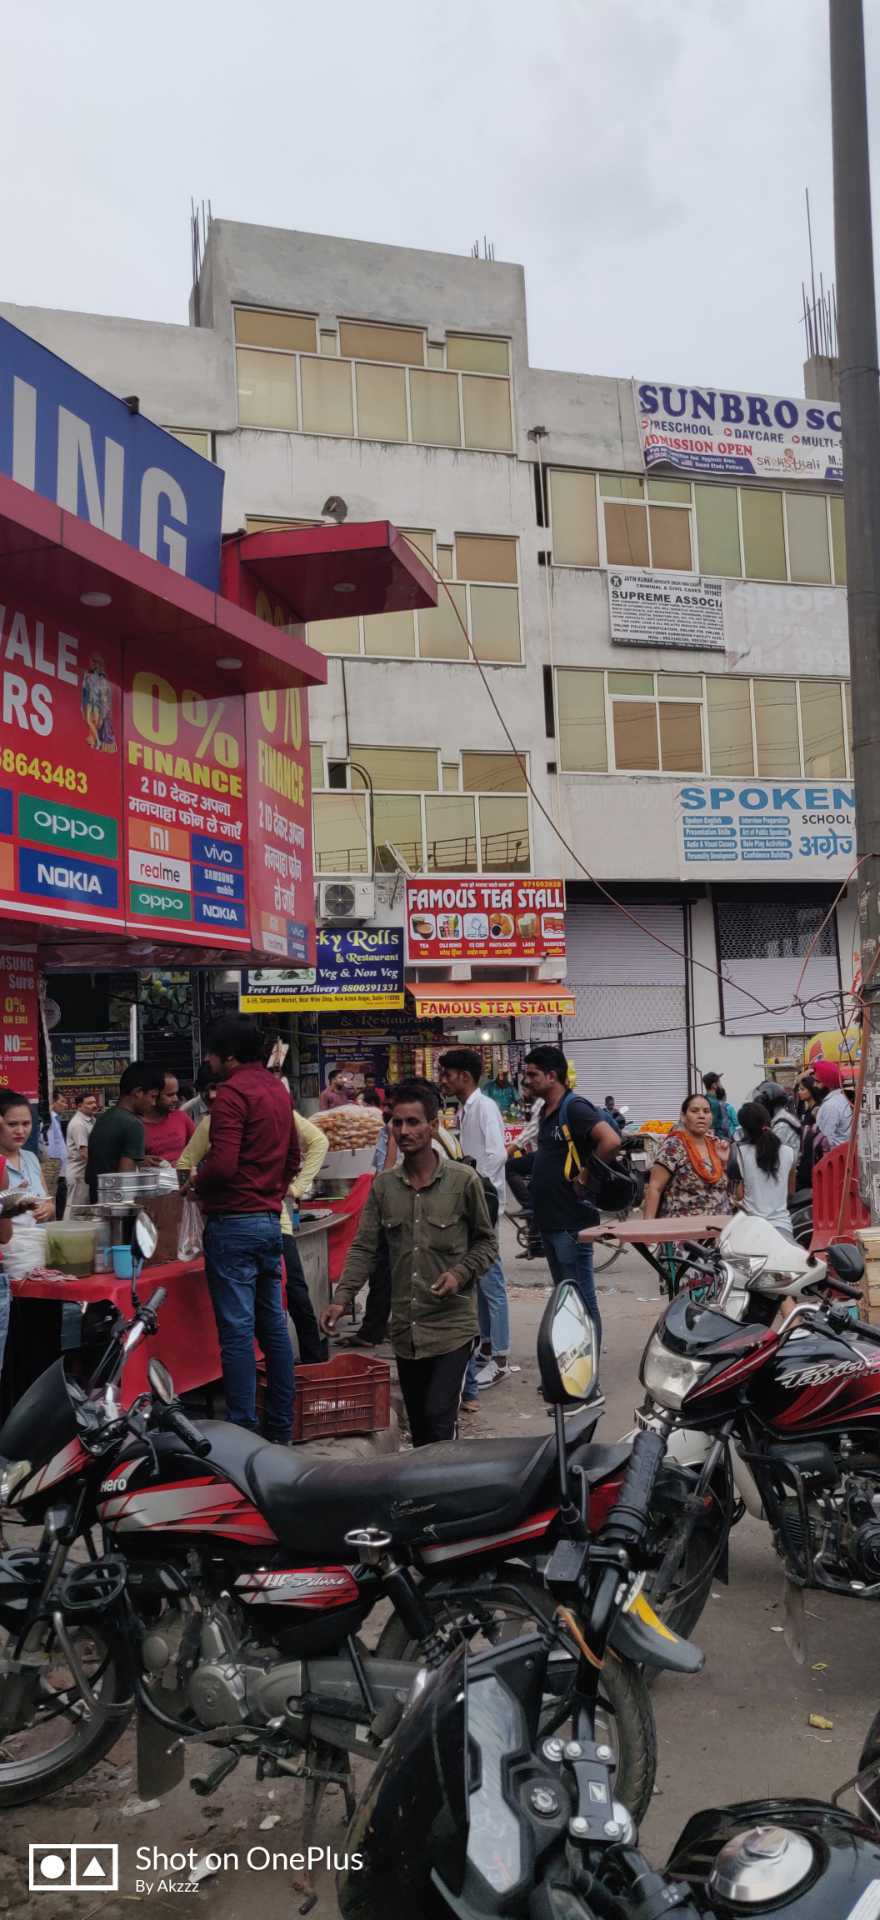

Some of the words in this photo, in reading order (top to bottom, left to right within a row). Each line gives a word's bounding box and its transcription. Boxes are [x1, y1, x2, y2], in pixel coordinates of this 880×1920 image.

[638, 385, 798, 430] SUNBRO
[645, 433, 713, 453] ADMISSION
[719, 442, 753, 456] OPEN
[735, 428, 785, 444] DAYCARE
[12, 376, 188, 577] ING
[612, 590, 671, 603] SUPREME
[3, 670, 54, 737] RS
[133, 671, 240, 769] 0%
[0, 747, 89, 794] 8643483
[128, 740, 243, 800] FINANCE
[258, 740, 304, 808] FINANCE
[140, 776, 150, 794] 2
[170, 783, 199, 808] देकर
[200, 796, 231, 817] अपना
[680, 787, 855, 811] SPOKEN
[179, 807, 204, 830] फोन
[802, 814, 852, 825] SCHOOL
[204, 844, 233, 863] vivo
[38, 864, 104, 895] NOKIA
[139, 862, 181, 883] realme
[408, 889, 477, 911] FAMOUS
[481, 889, 512, 910] TEA
[517, 888, 564, 910] STALL
[203, 903, 238, 920] NOKIA
[316, 931, 341, 954] ky
[346, 928, 399, 952] Rolls
[336, 953, 344, 964] &
[346, 953, 399, 965] Restaurant
[9, 974, 34, 989] Sure
[319, 968, 338, 980] Veg
[340, 969, 353, 978] &
[354, 970, 378, 978] Non
[381, 968, 399, 980] Veg
[248, 985, 269, 995] Free
[270, 984, 299, 994] Home
[300, 983, 340, 995] Delivery
[5, 996, 25, 1013] 0%
[420, 1002, 483, 1014] FAMOUS
[486, 1002, 515, 1014] TEA
[519, 1001, 564, 1013] STALL
[100, 1478, 126, 1493] Hero
[290, 1574, 347, 1588] Deluxe
